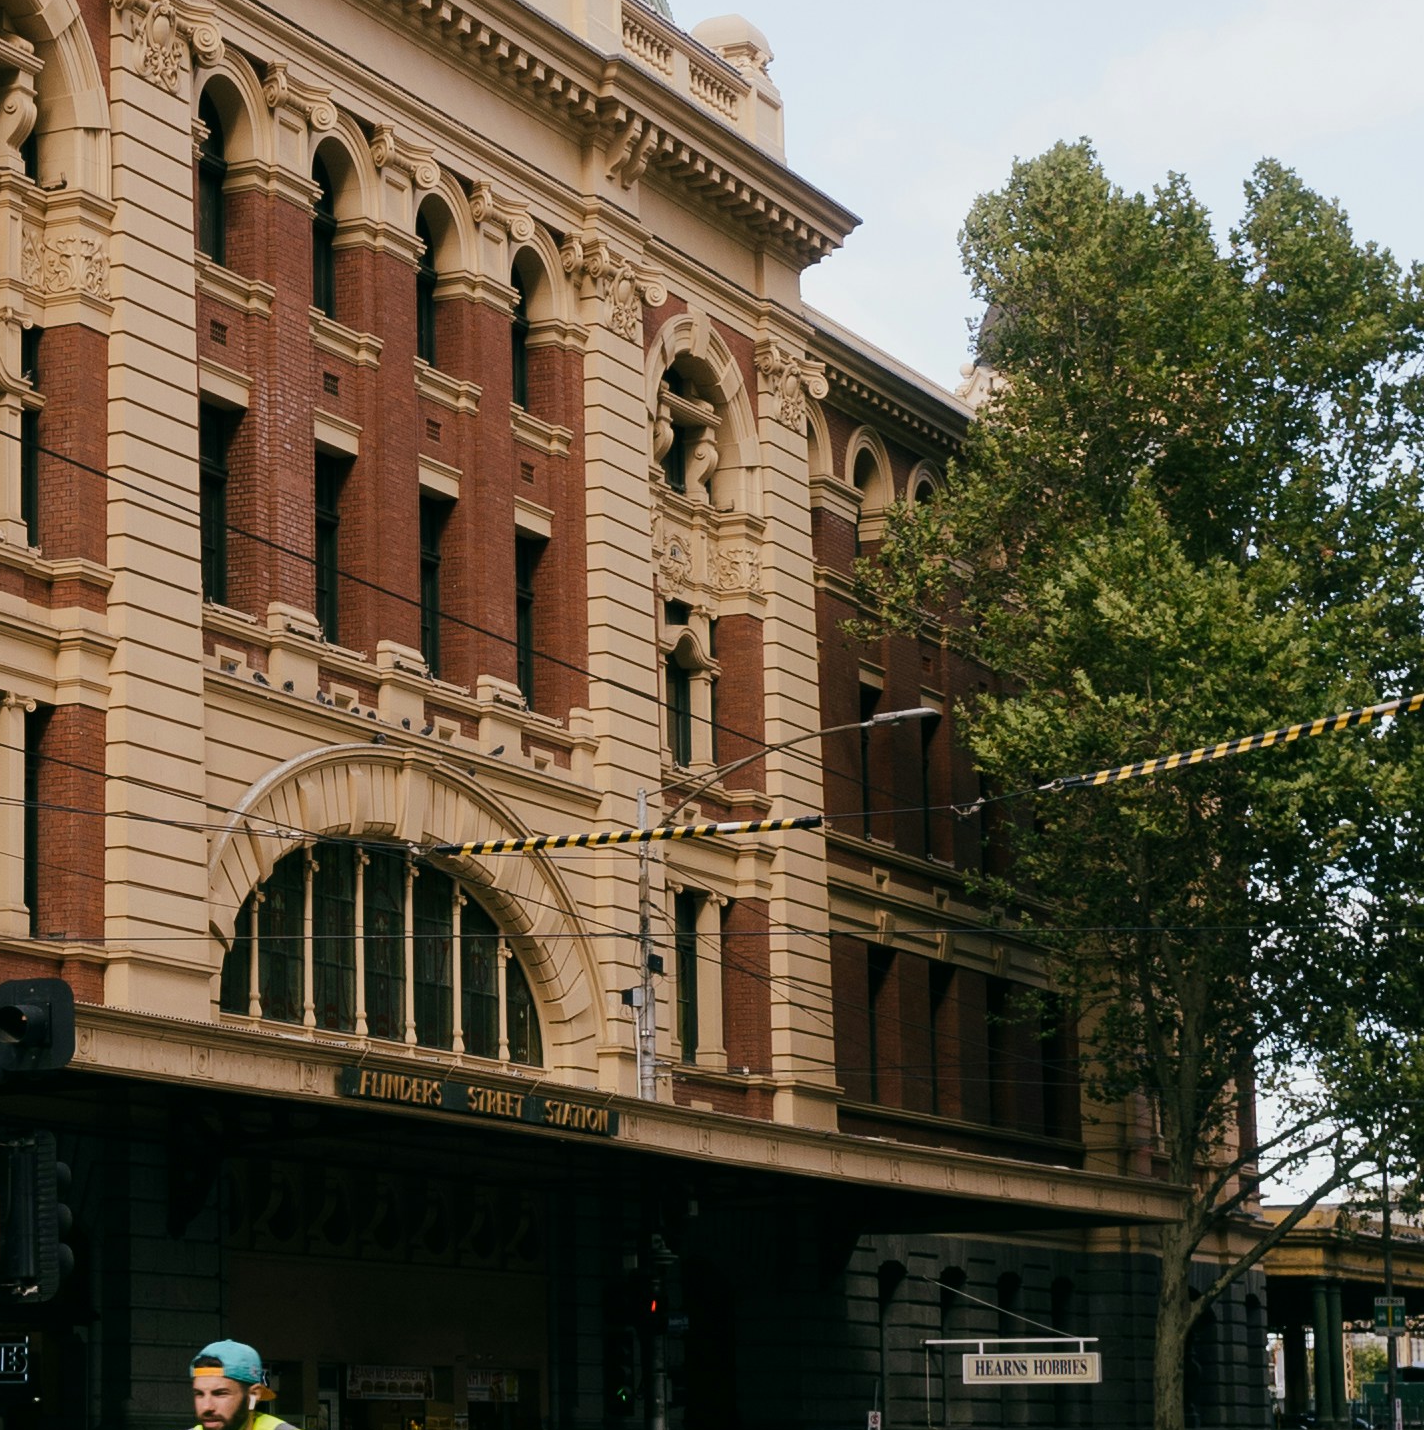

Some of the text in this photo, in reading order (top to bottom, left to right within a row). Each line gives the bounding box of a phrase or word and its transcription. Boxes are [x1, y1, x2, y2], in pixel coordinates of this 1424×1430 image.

[360, 1070, 608, 1132] FLINDERS STREET STATION
[975, 1358, 1088, 1376] HEARNS HOBBIES
